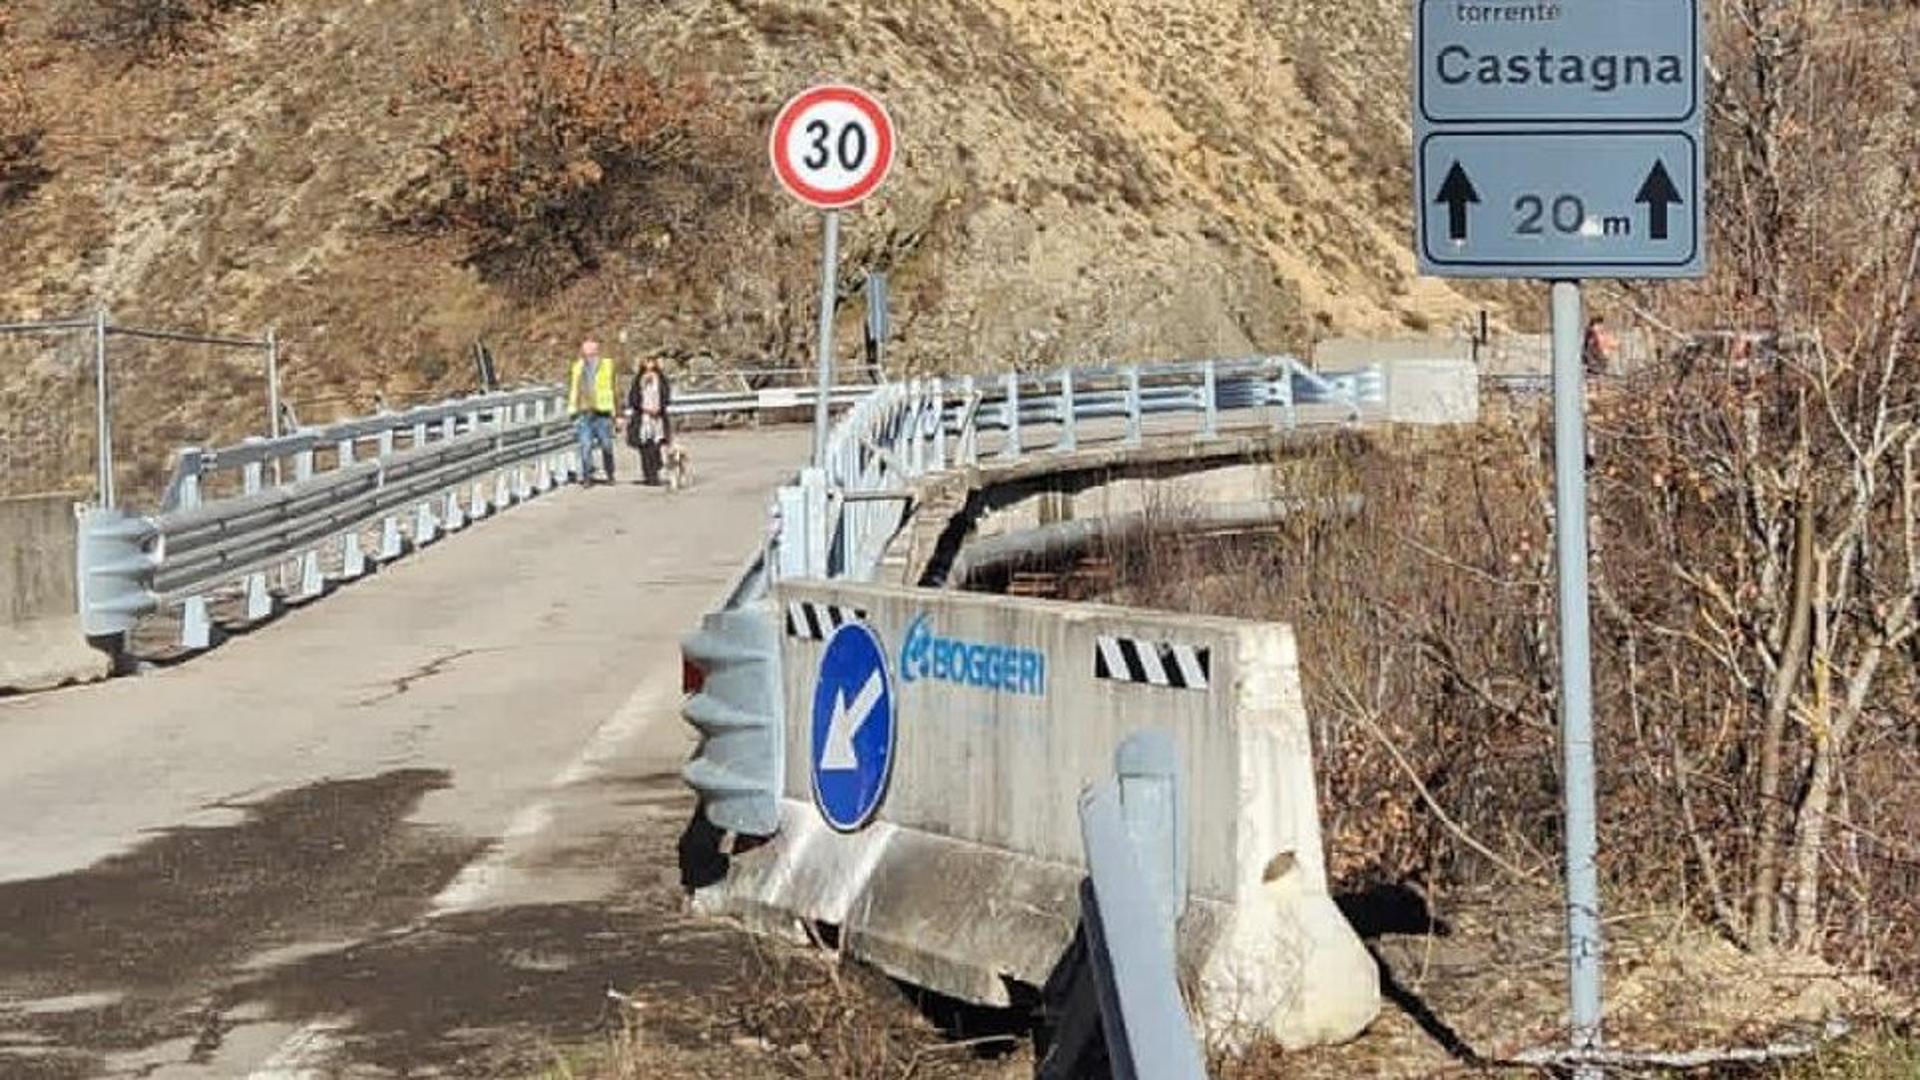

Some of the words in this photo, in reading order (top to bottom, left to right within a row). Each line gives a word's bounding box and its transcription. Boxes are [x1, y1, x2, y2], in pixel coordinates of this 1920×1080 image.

[1456, 3, 1560, 22] torrente
[1436, 44, 1683, 92] Castagna
[803, 119, 867, 171] 30
[1514, 194, 1584, 234] 20
[933, 637, 1045, 696] BOGGERI
